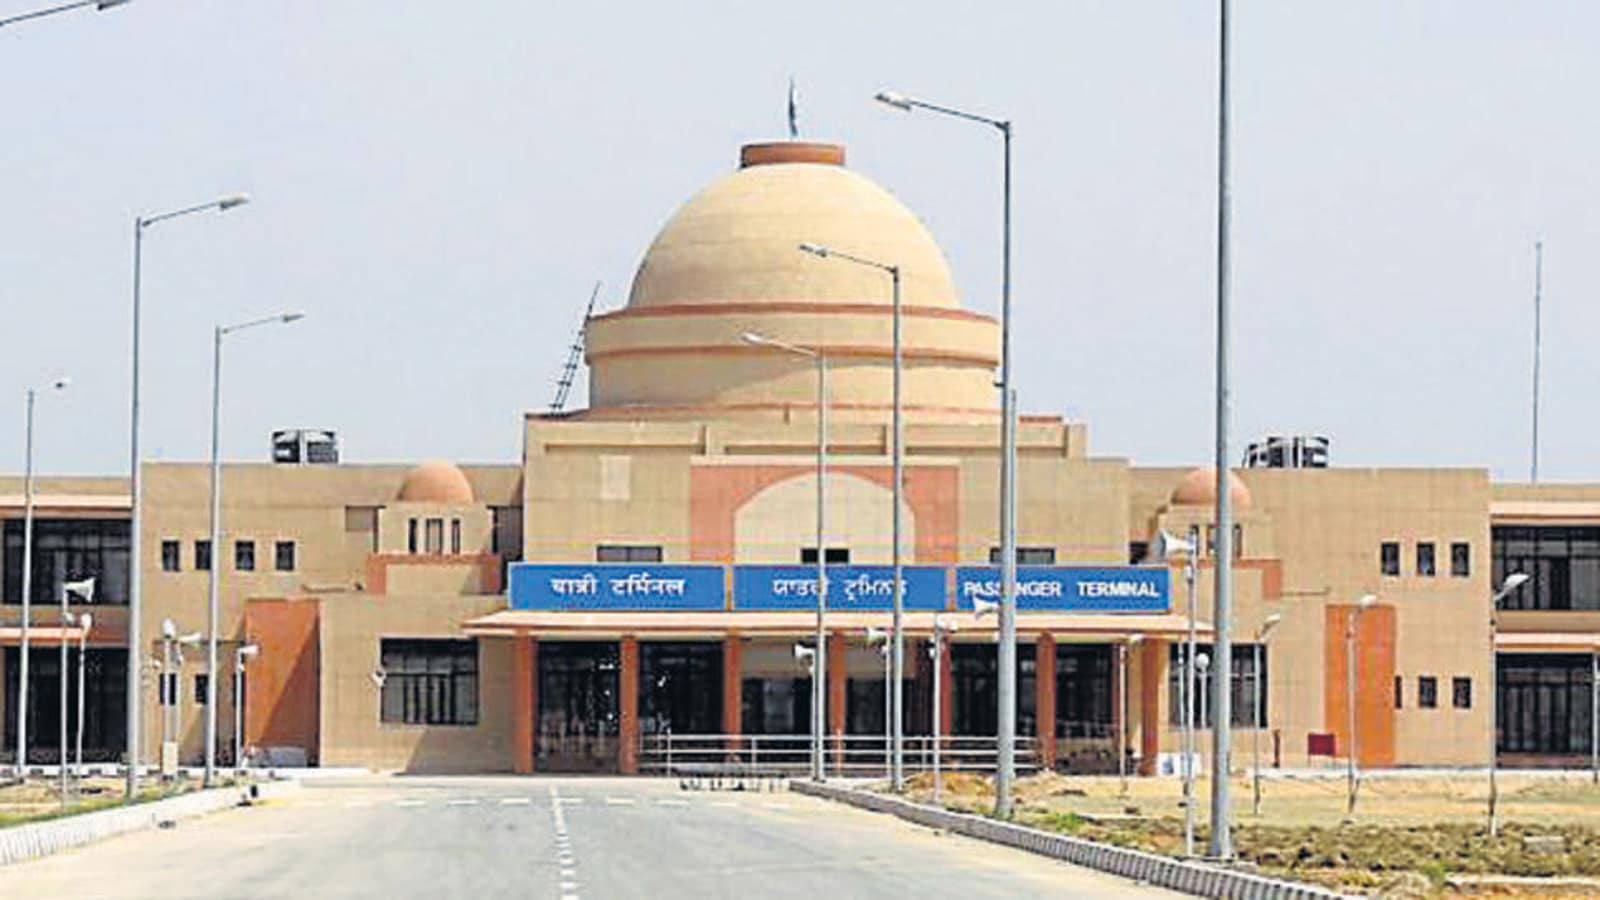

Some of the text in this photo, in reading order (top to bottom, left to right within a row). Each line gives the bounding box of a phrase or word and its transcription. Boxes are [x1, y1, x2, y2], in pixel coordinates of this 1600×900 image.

[551, 571, 686, 595] यात्री टर्मिनल
[963, 580, 1161, 598] PASSNGER TERMINAL
